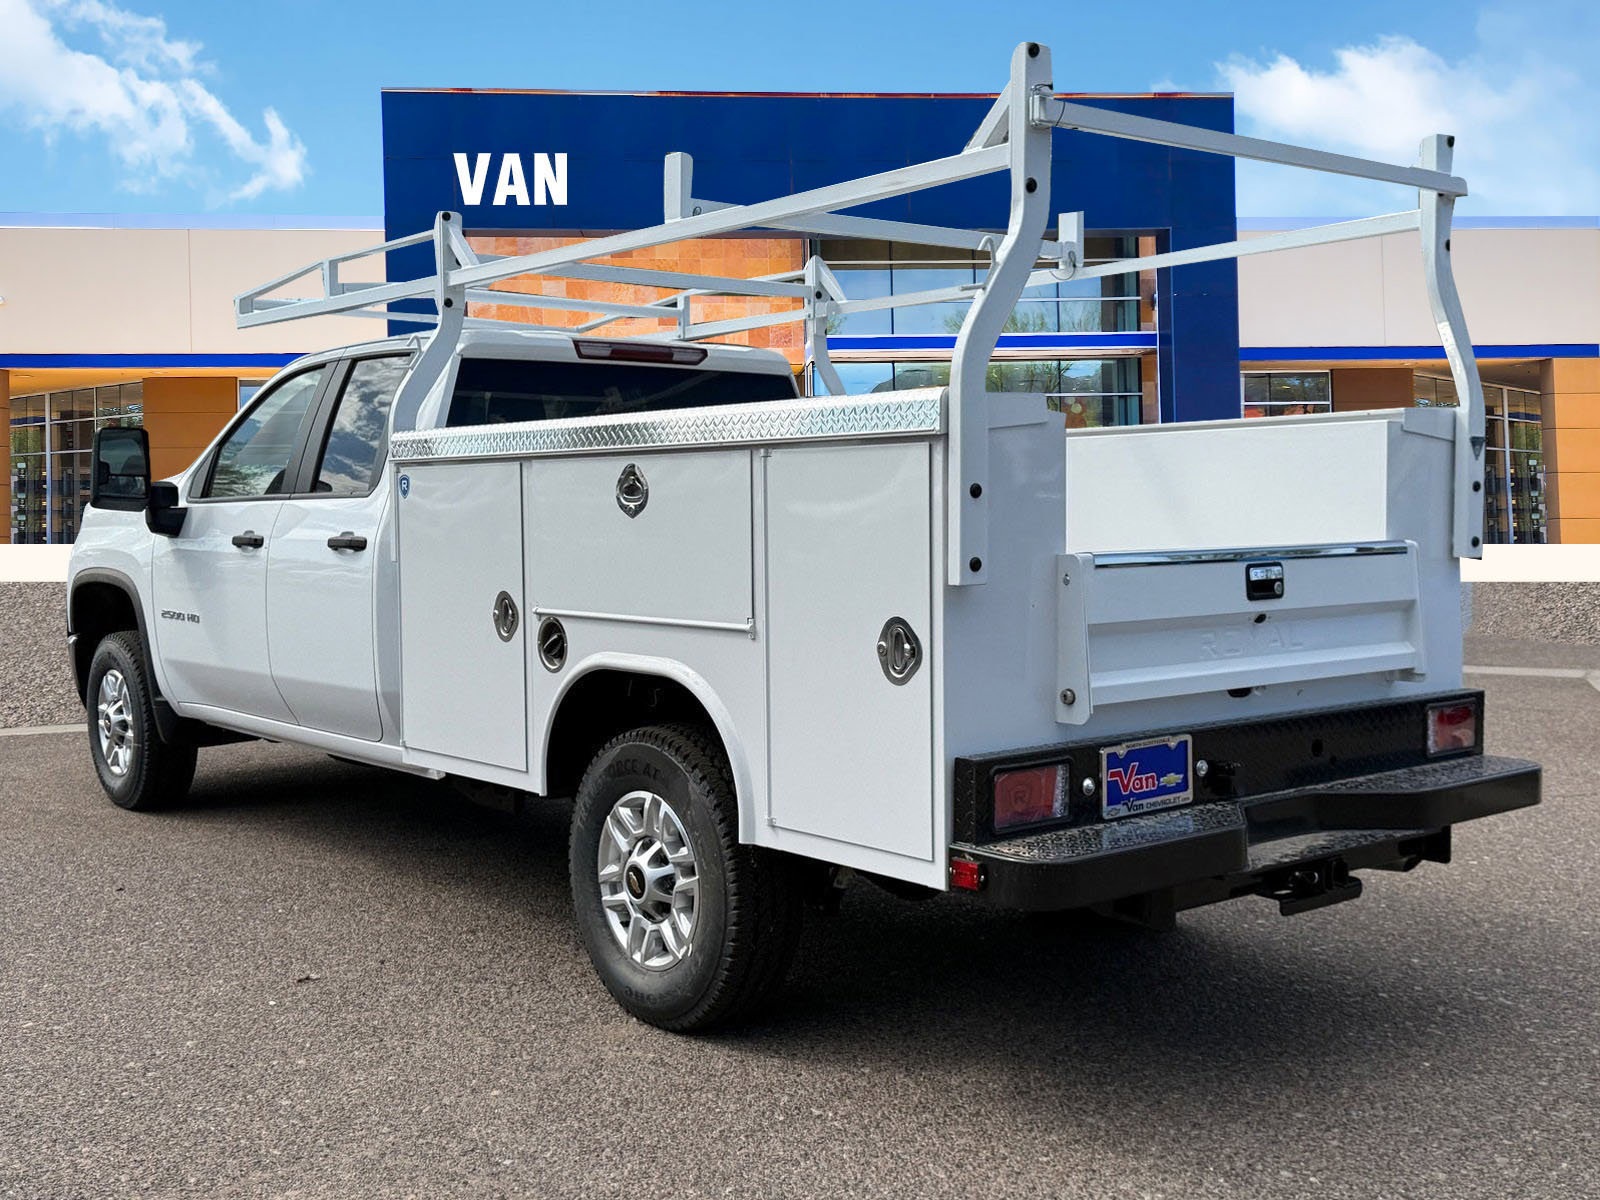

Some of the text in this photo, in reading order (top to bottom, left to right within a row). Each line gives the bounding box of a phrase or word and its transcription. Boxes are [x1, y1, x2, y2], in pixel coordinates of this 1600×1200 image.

[453, 152, 568, 205] VAN
[161, 609, 200, 624] 2500 HD
[1199, 622, 1304, 659] ROYAL
[1108, 762, 1158, 794] Van
[1122, 798, 1144, 812] Van
